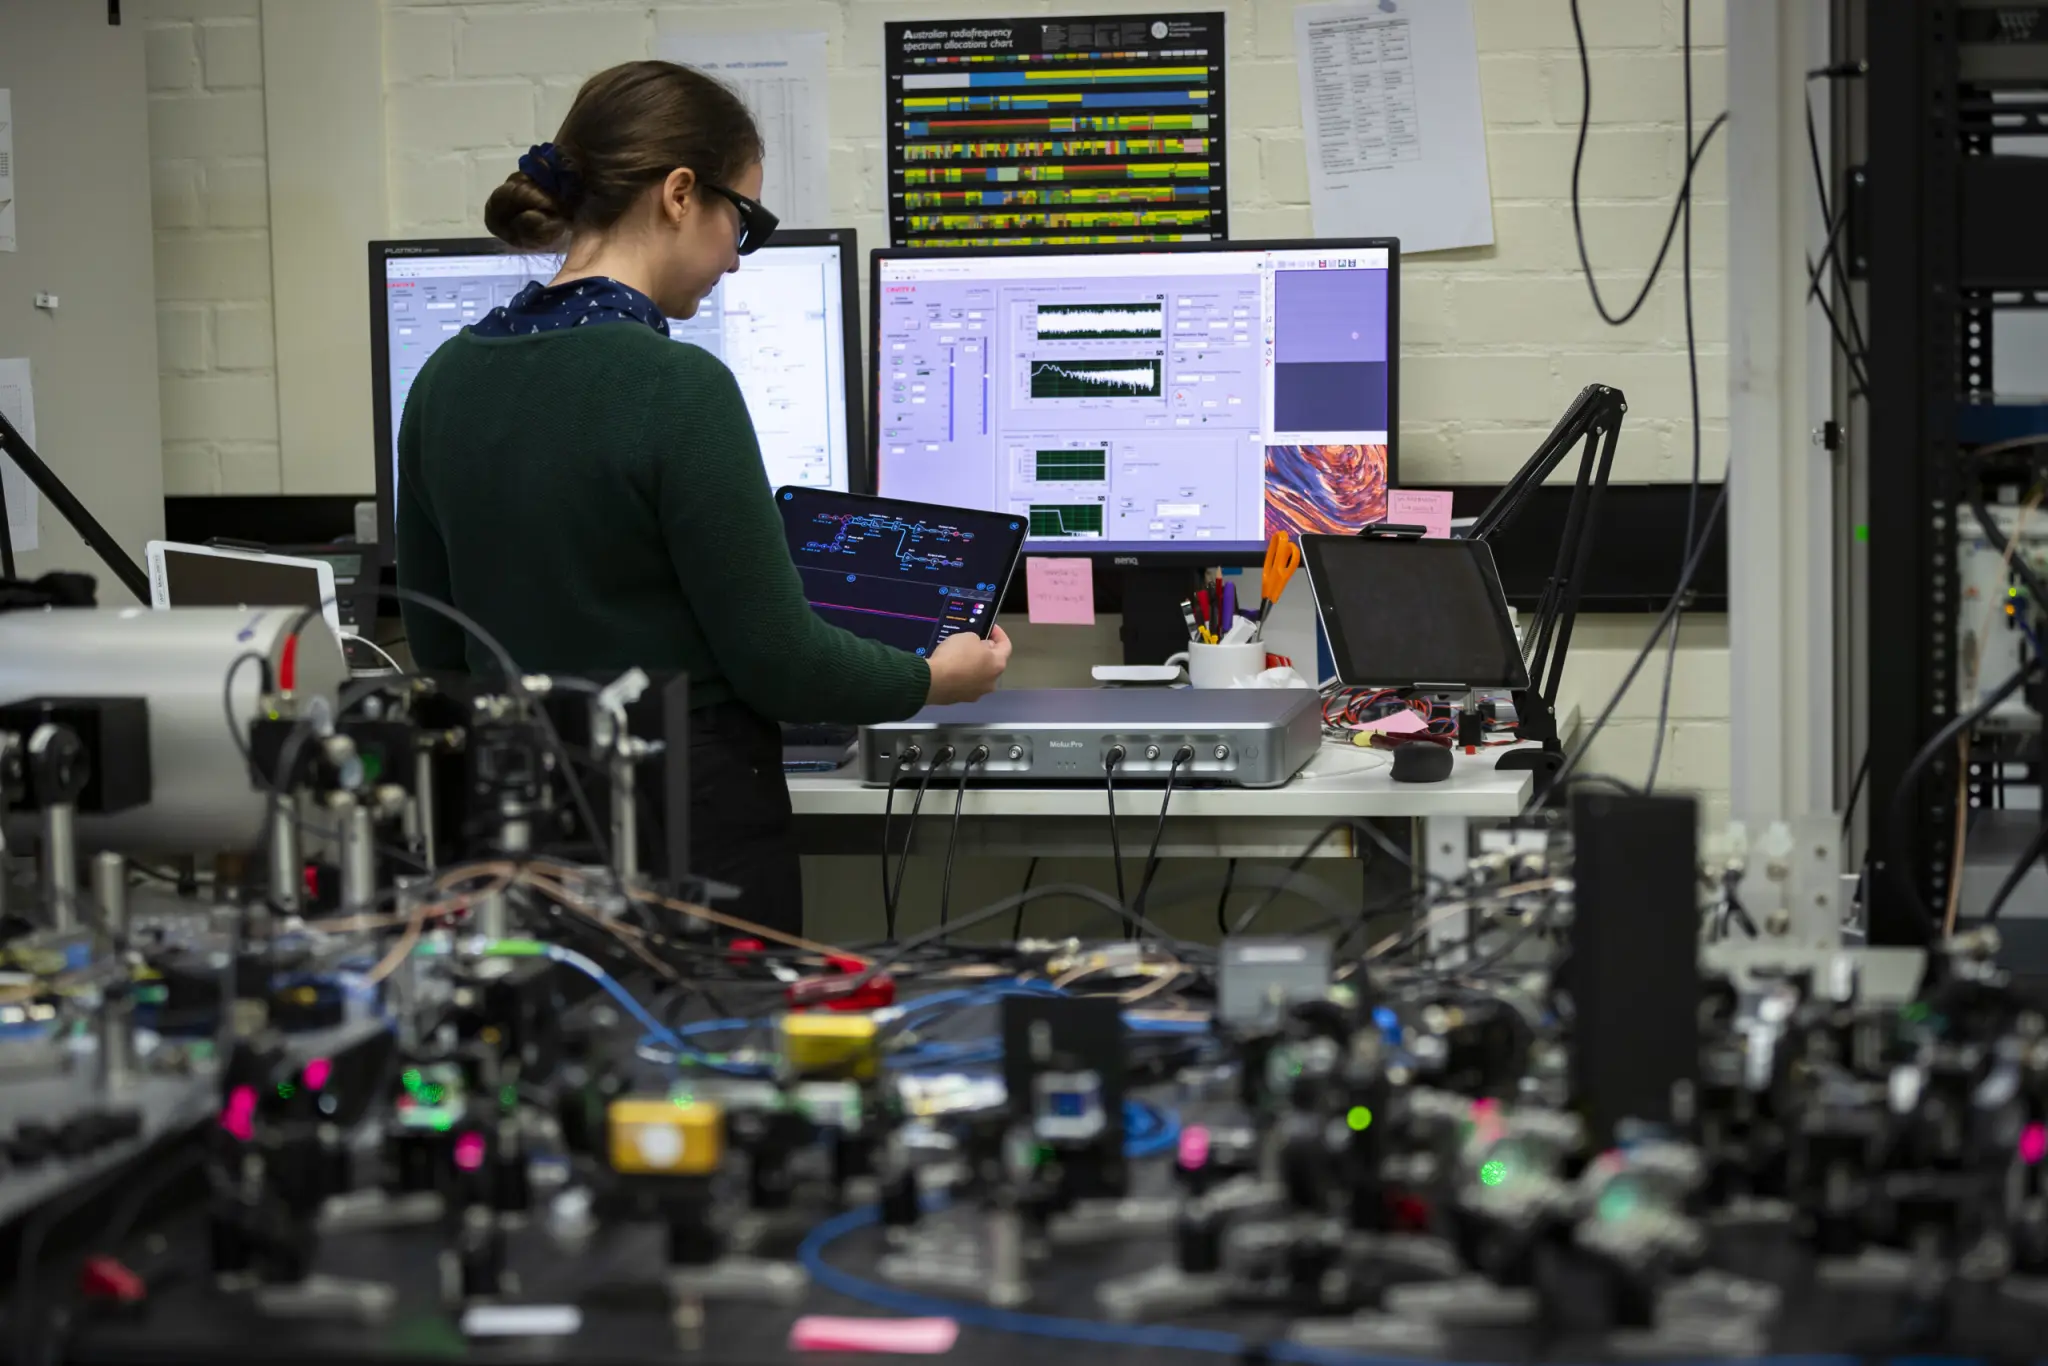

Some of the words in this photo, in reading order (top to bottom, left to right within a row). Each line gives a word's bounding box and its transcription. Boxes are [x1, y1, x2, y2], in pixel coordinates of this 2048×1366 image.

[903, 29, 948, 40] Australian
[950, 28, 1013, 40] radiofrequency
[903, 42, 942, 53] spectrum
[944, 39, 988, 50] allocations
[989, 39, 1014, 49] chart
